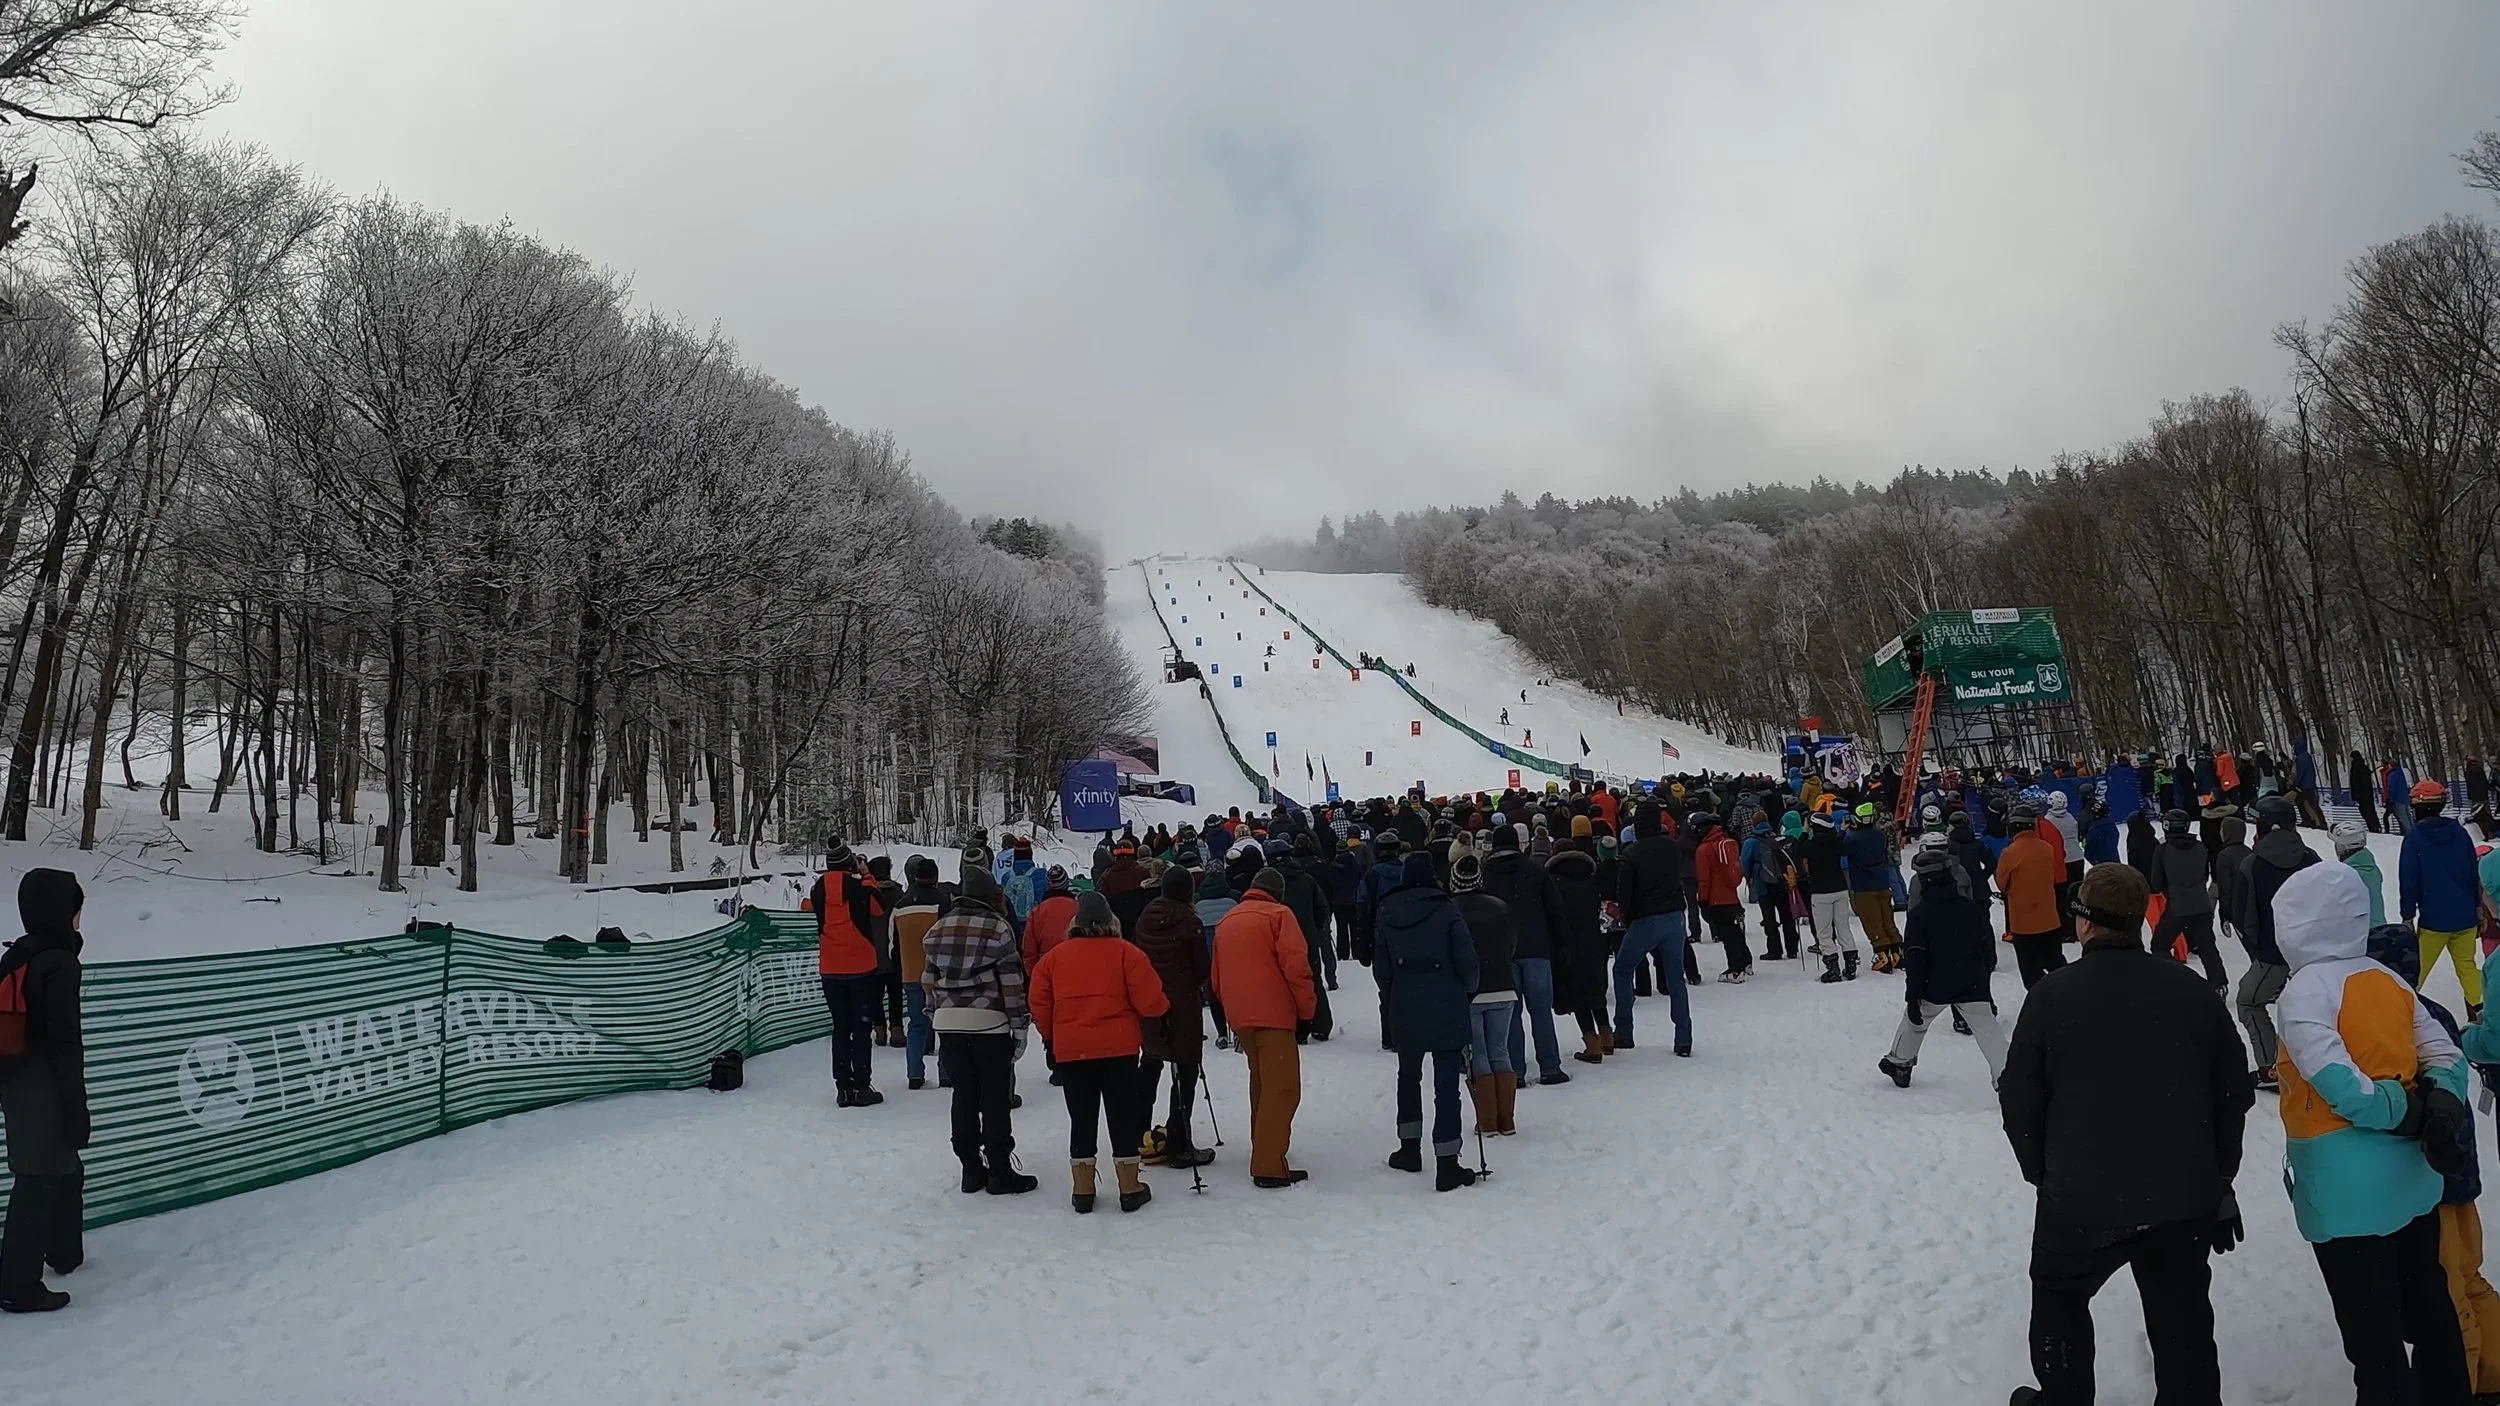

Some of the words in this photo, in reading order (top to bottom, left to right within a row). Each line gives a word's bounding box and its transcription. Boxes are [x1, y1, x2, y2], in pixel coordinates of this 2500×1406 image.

[1950, 634, 1993, 646] RESORT
[1971, 670, 1987, 679] SKI
[1988, 668, 2015, 677] YOUR
[1955, 682, 2002, 699] National
[2001, 680, 2035, 695] Forest
[1073, 787, 1116, 808] xfinity
[2071, 901, 2091, 916] SMITH
[298, 990, 594, 1066] WATERVILLE
[305, 1041, 447, 1103] VALLEY
[467, 1032, 600, 1063] RESORT
